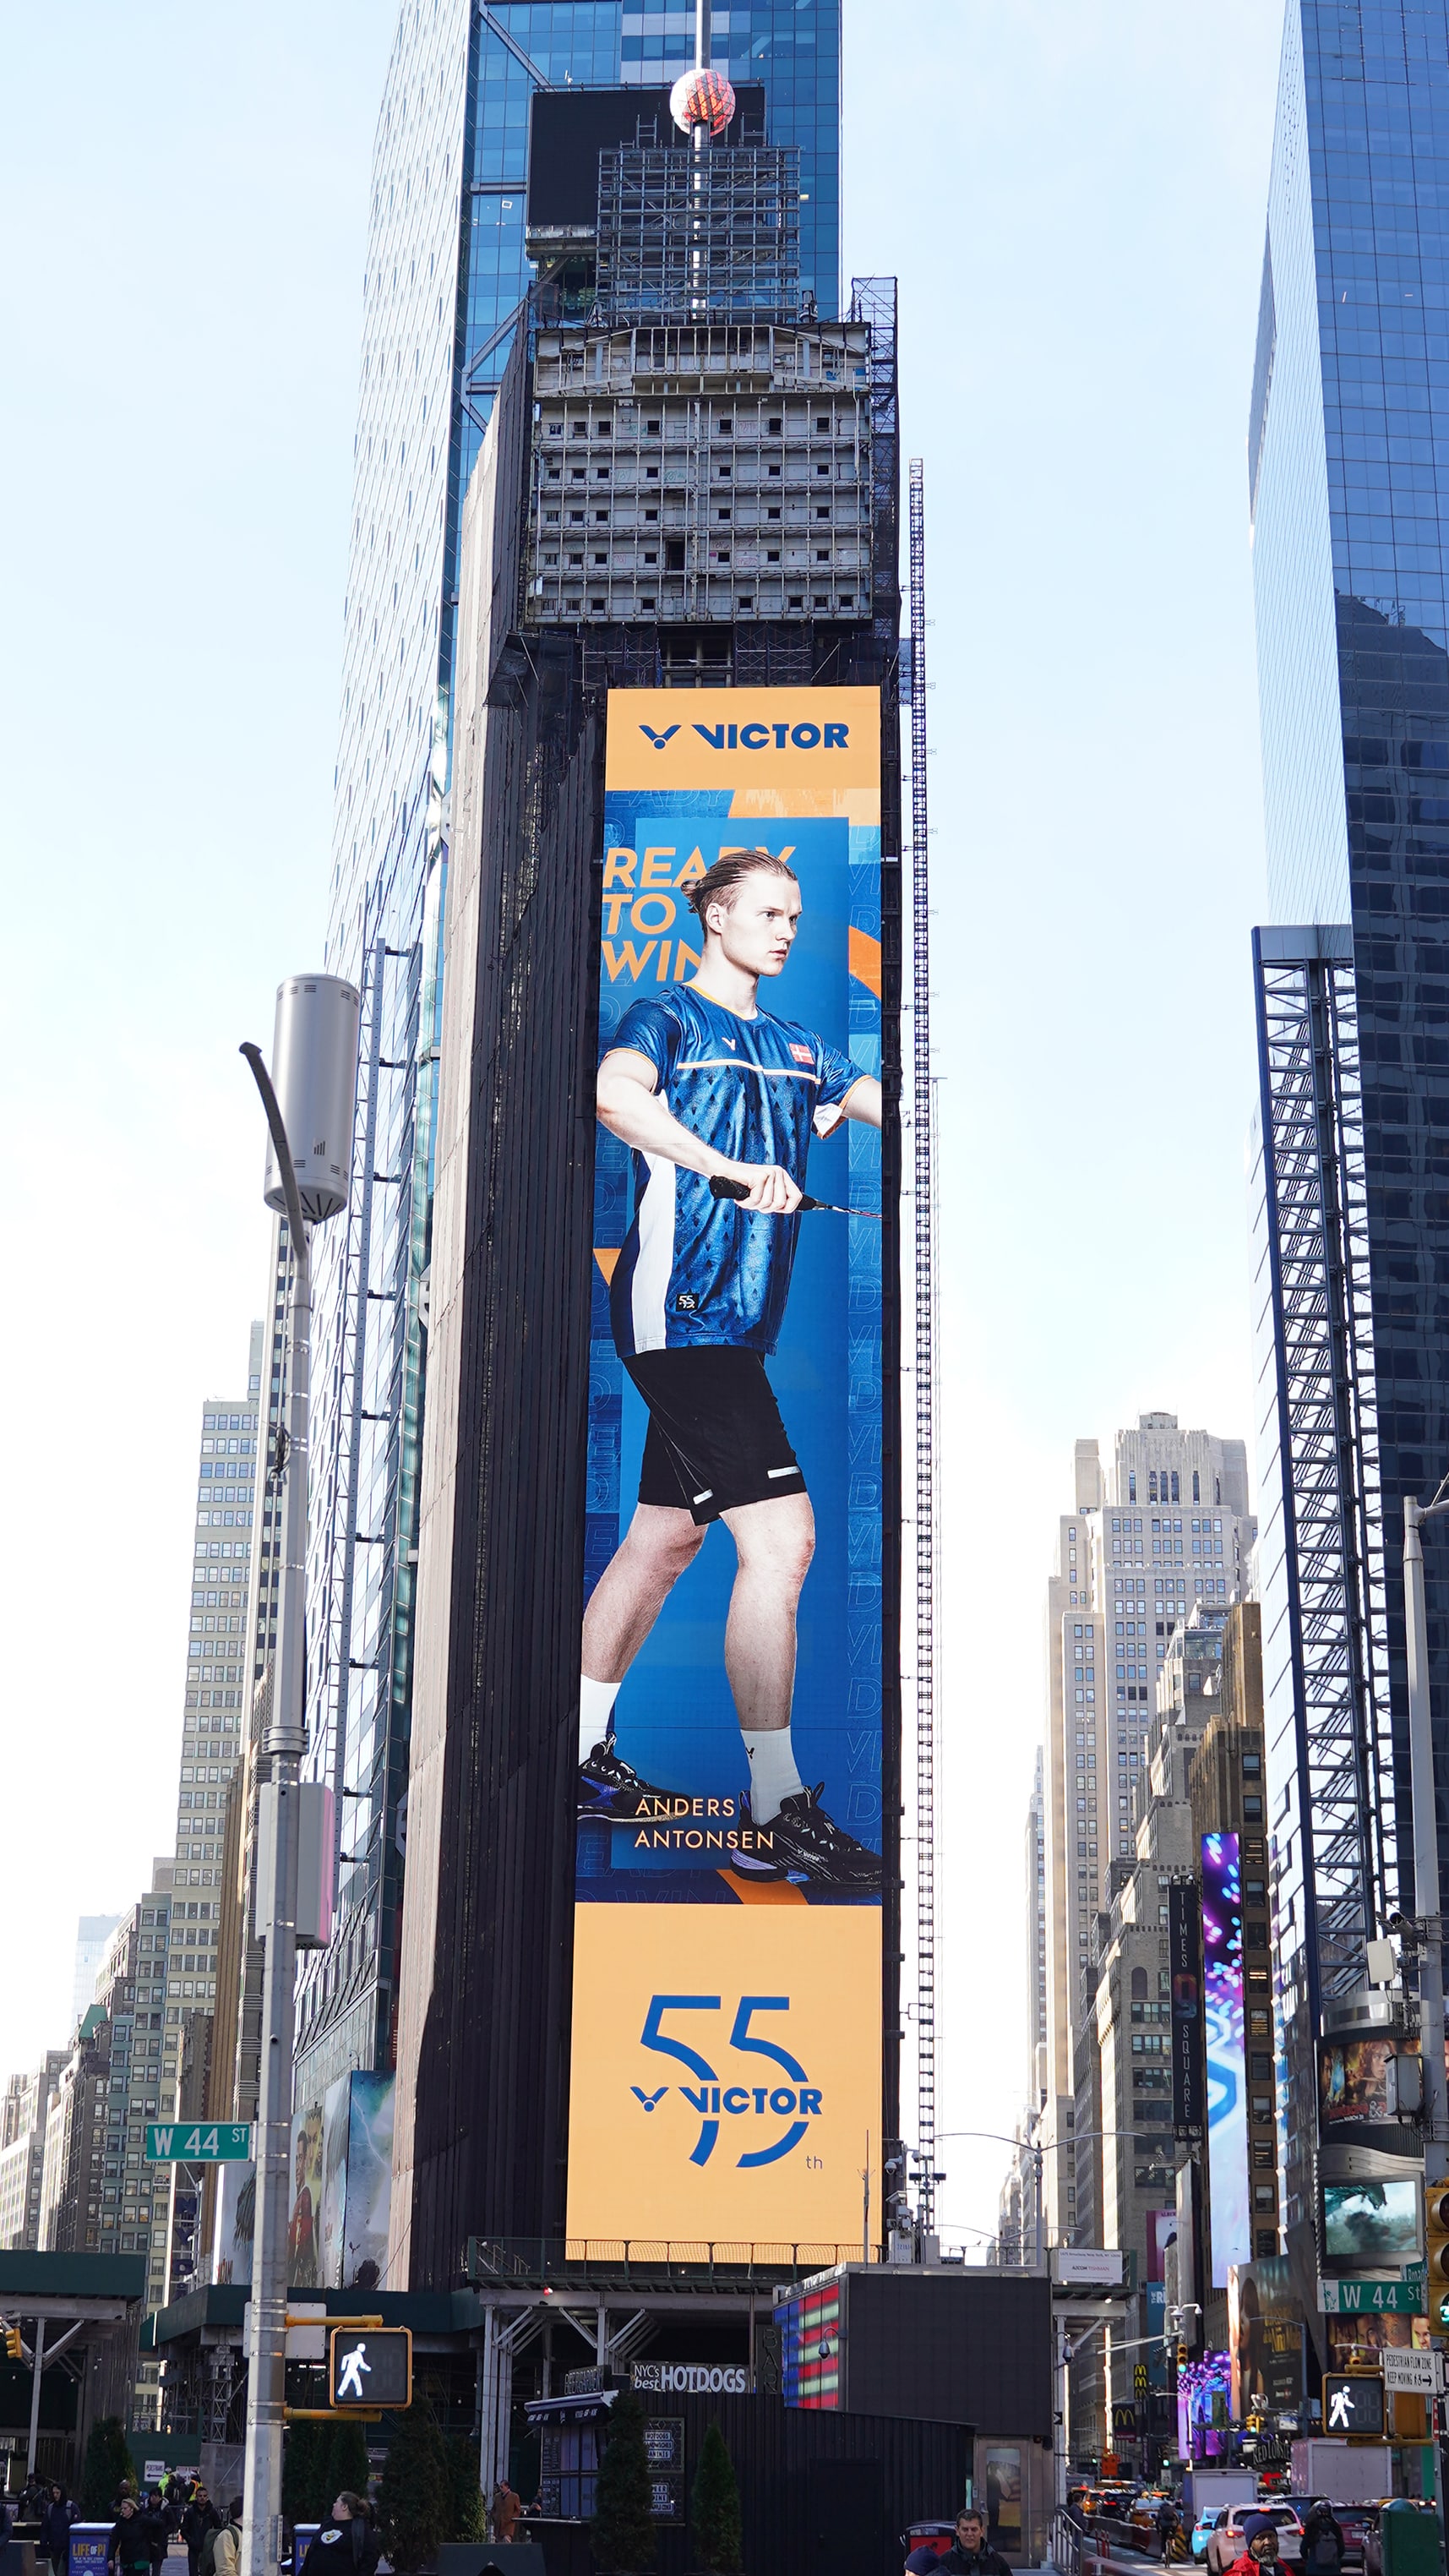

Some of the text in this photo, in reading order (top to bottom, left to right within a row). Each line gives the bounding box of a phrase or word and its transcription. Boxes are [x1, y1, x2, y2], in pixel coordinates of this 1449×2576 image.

[693, 723, 849, 750] VICTOR
[602, 893, 676, 935] TO
[635, 1798, 734, 1818] ANDERS
[634, 1830, 774, 1850] ANTONSEN
[1179, 1891, 1188, 1967] TIMES
[1181, 2024, 1190, 2118] SQUARE
[678, 2088, 823, 2115] VICTOR
[153, 2127, 248, 2157] W 44 ST
[805, 2156, 823, 2169] th
[1343, 2285, 1361, 2309] W
[1372, 2285, 1398, 2309] 44
[635, 2365, 660, 2377] NYC's
[1386, 2354, 1432, 2370] PEDESTRIAN FLOW ZONE
[635, 2377, 660, 2390] best
[661, 2366, 746, 2393] HOTDOGS
[1386, 2371, 1413, 2385] KEEP MOVING
[73, 2543, 106, 2557] LIFE OF PI
